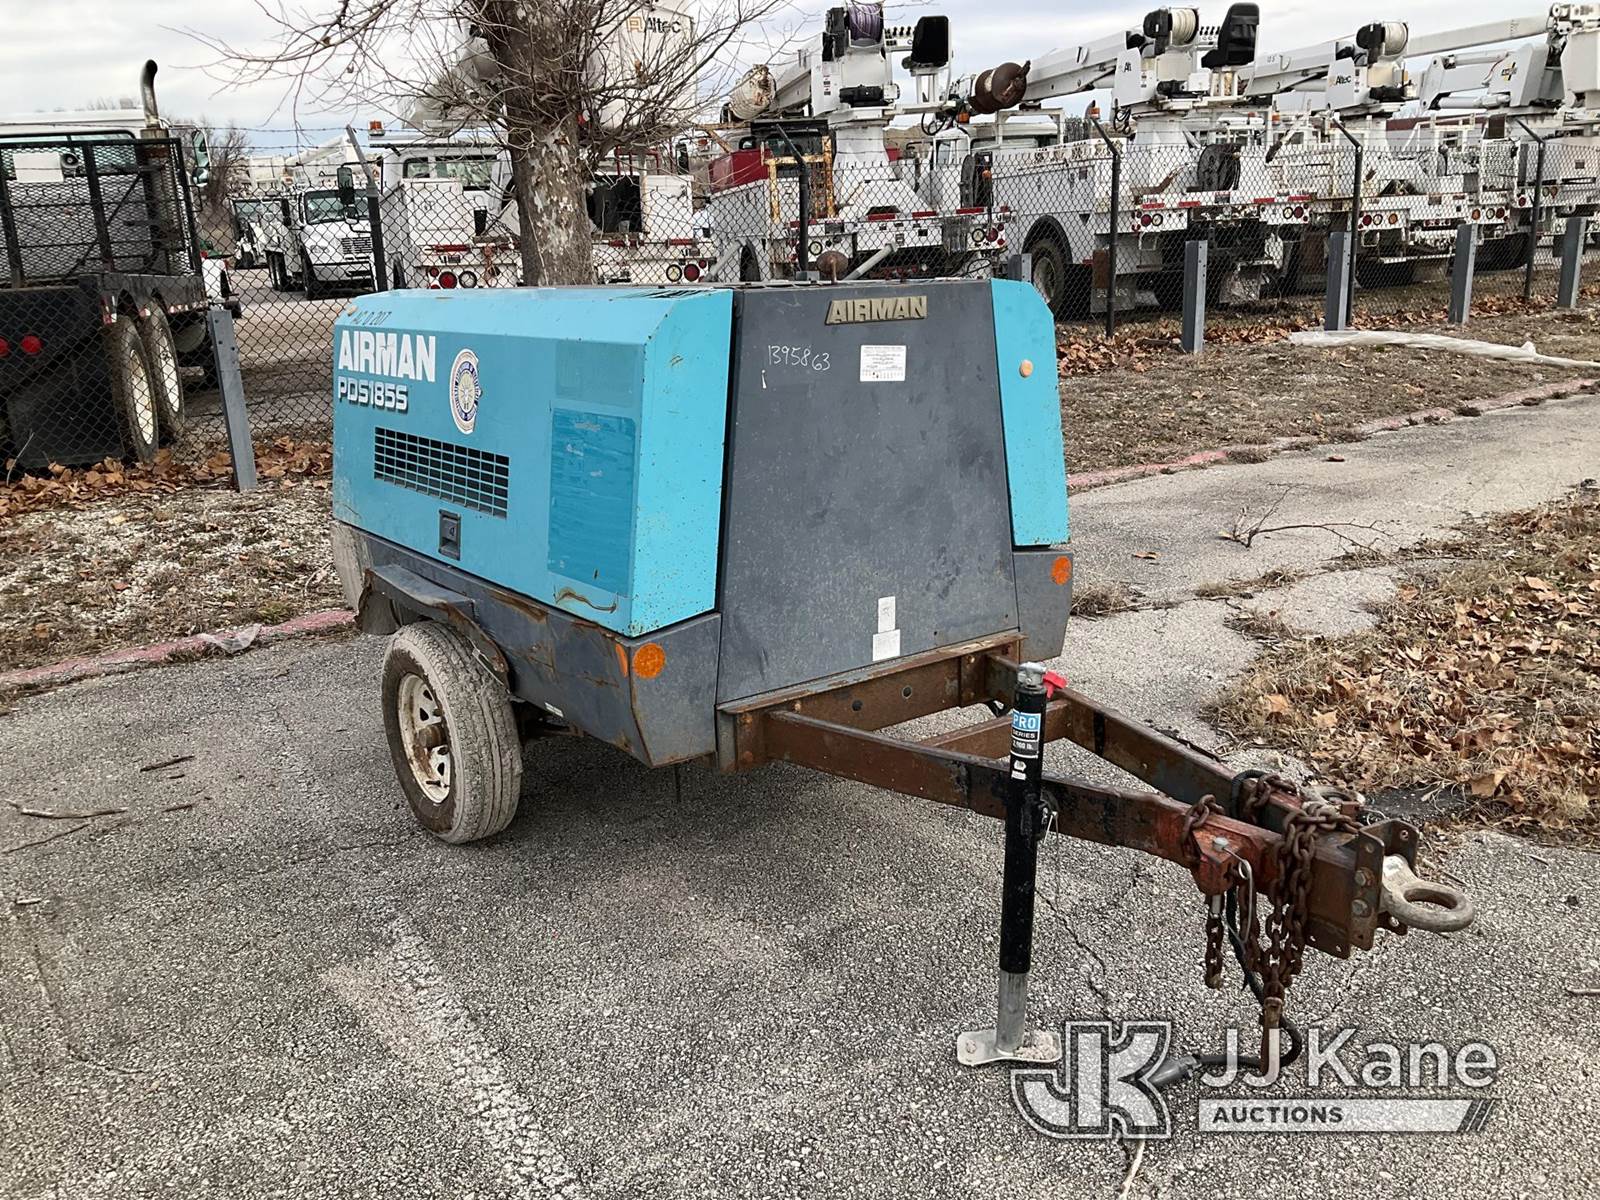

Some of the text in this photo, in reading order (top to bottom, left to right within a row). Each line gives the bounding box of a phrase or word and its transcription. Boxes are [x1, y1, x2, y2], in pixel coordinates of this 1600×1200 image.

[825, 295, 928, 325] AIRMAN
[338, 330, 436, 383] AIRMAN
[768, 344, 831, 371] 1395863
[338, 376, 409, 412] PDS185S
[1012, 728, 1036, 739] SERIES
[1013, 714, 1036, 729] PRO
